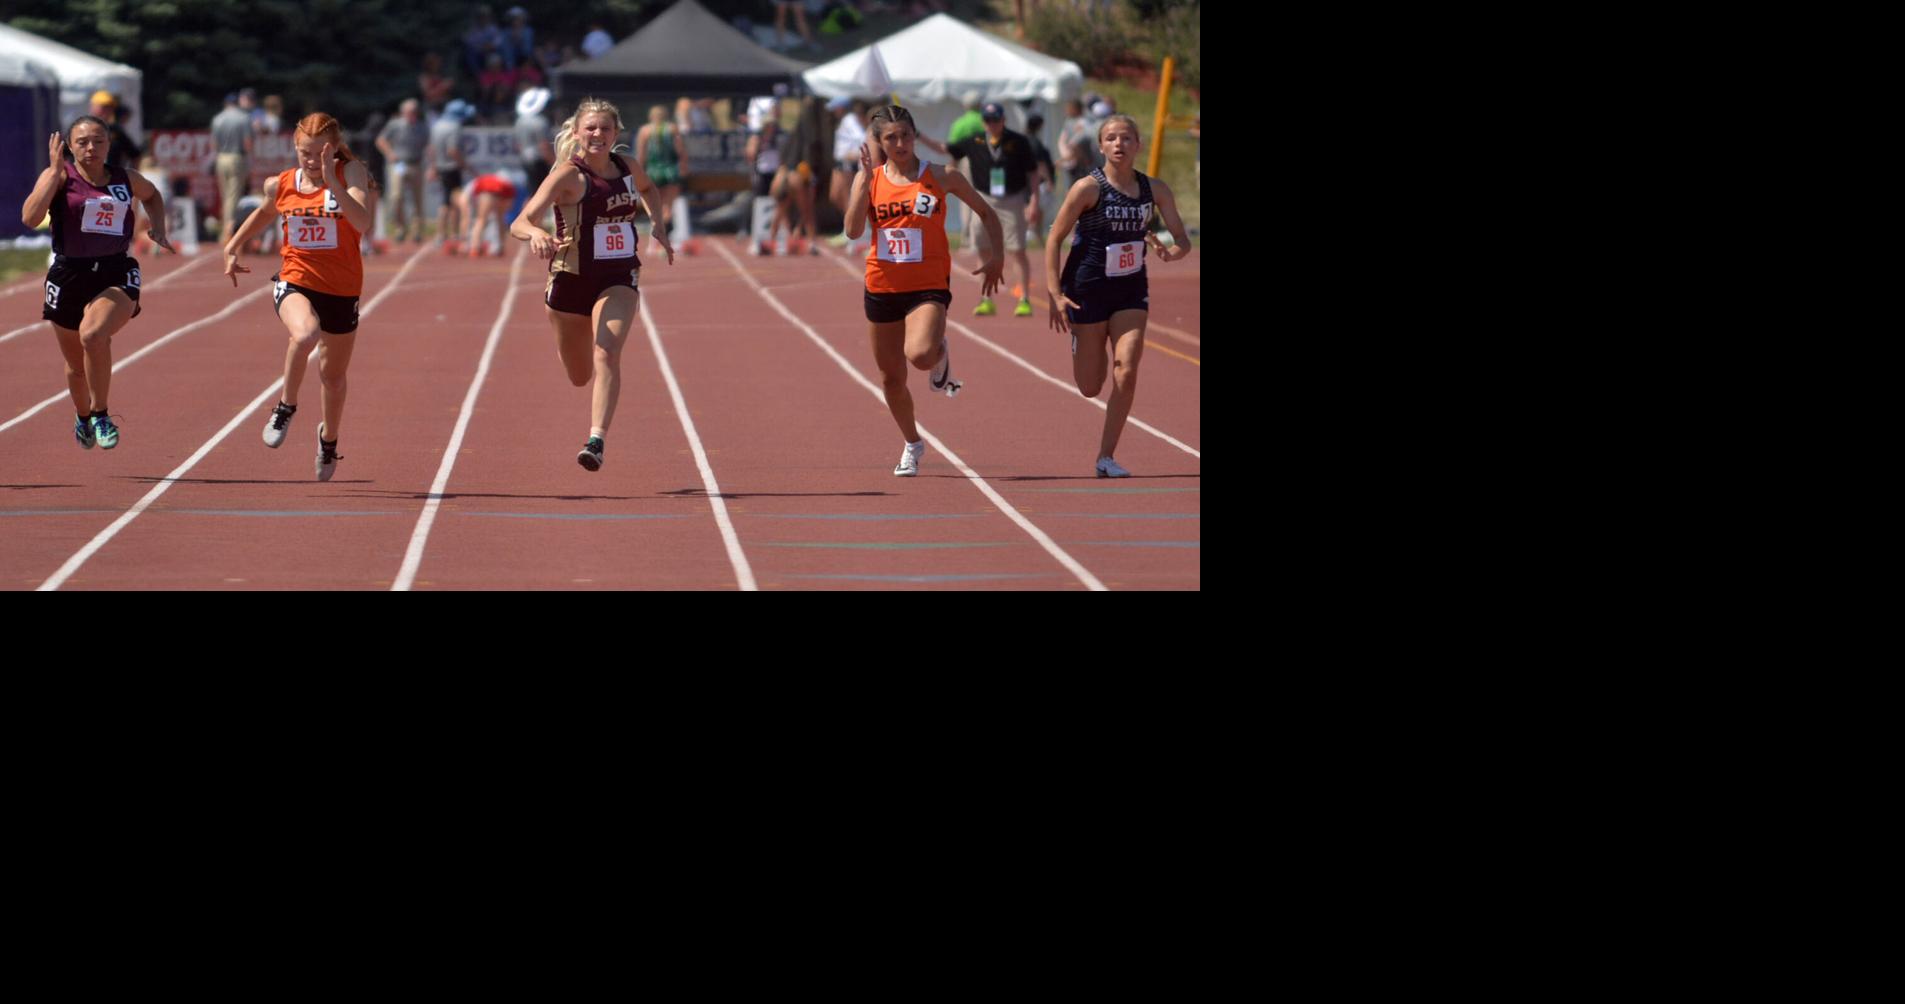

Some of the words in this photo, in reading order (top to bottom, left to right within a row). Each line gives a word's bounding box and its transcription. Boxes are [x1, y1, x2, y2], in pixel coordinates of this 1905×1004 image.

[112, 185, 128, 202] 6
[917, 194, 932, 214] 3
[95, 211, 114, 227] 25
[298, 226, 326, 242] 212
[606, 234, 625, 251] 96
[887, 239, 910, 255] 211
[1119, 252, 1135, 269] 60
[47, 284, 58, 304] 6
